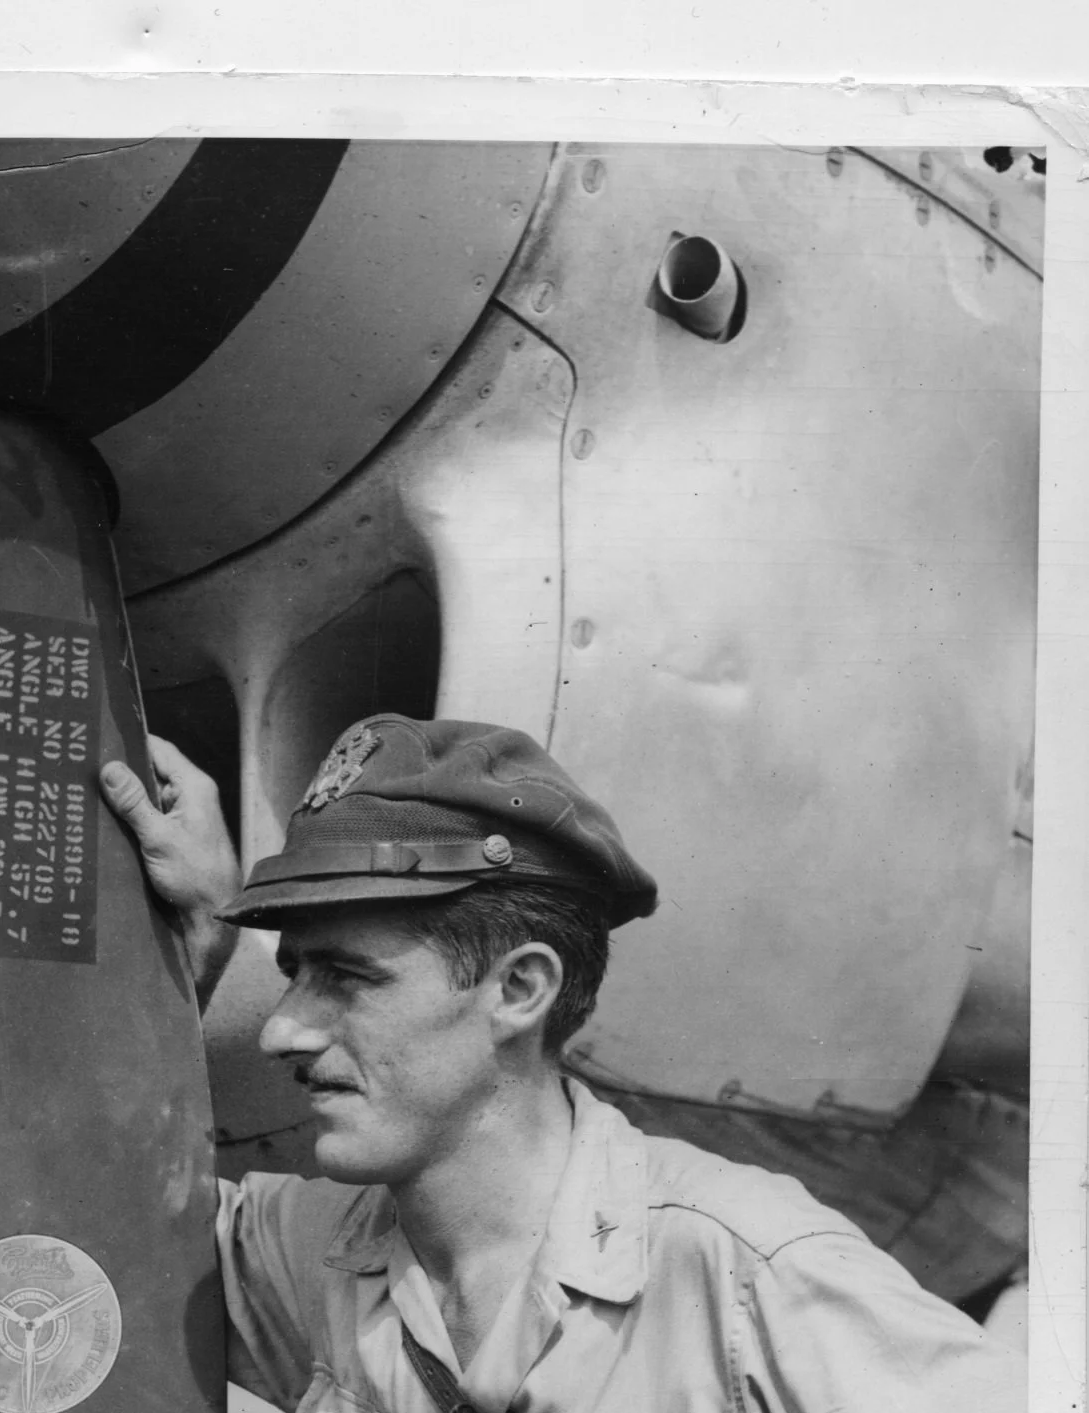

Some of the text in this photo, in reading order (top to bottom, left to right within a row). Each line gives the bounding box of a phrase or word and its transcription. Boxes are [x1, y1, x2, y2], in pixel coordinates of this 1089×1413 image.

[69, 722, 86, 761] NO
[71, 638, 89, 698] DWG
[7, 633, 42, 942] ANGLE HIGH 57.7
[33, 637, 65, 903] SER NO 222709
